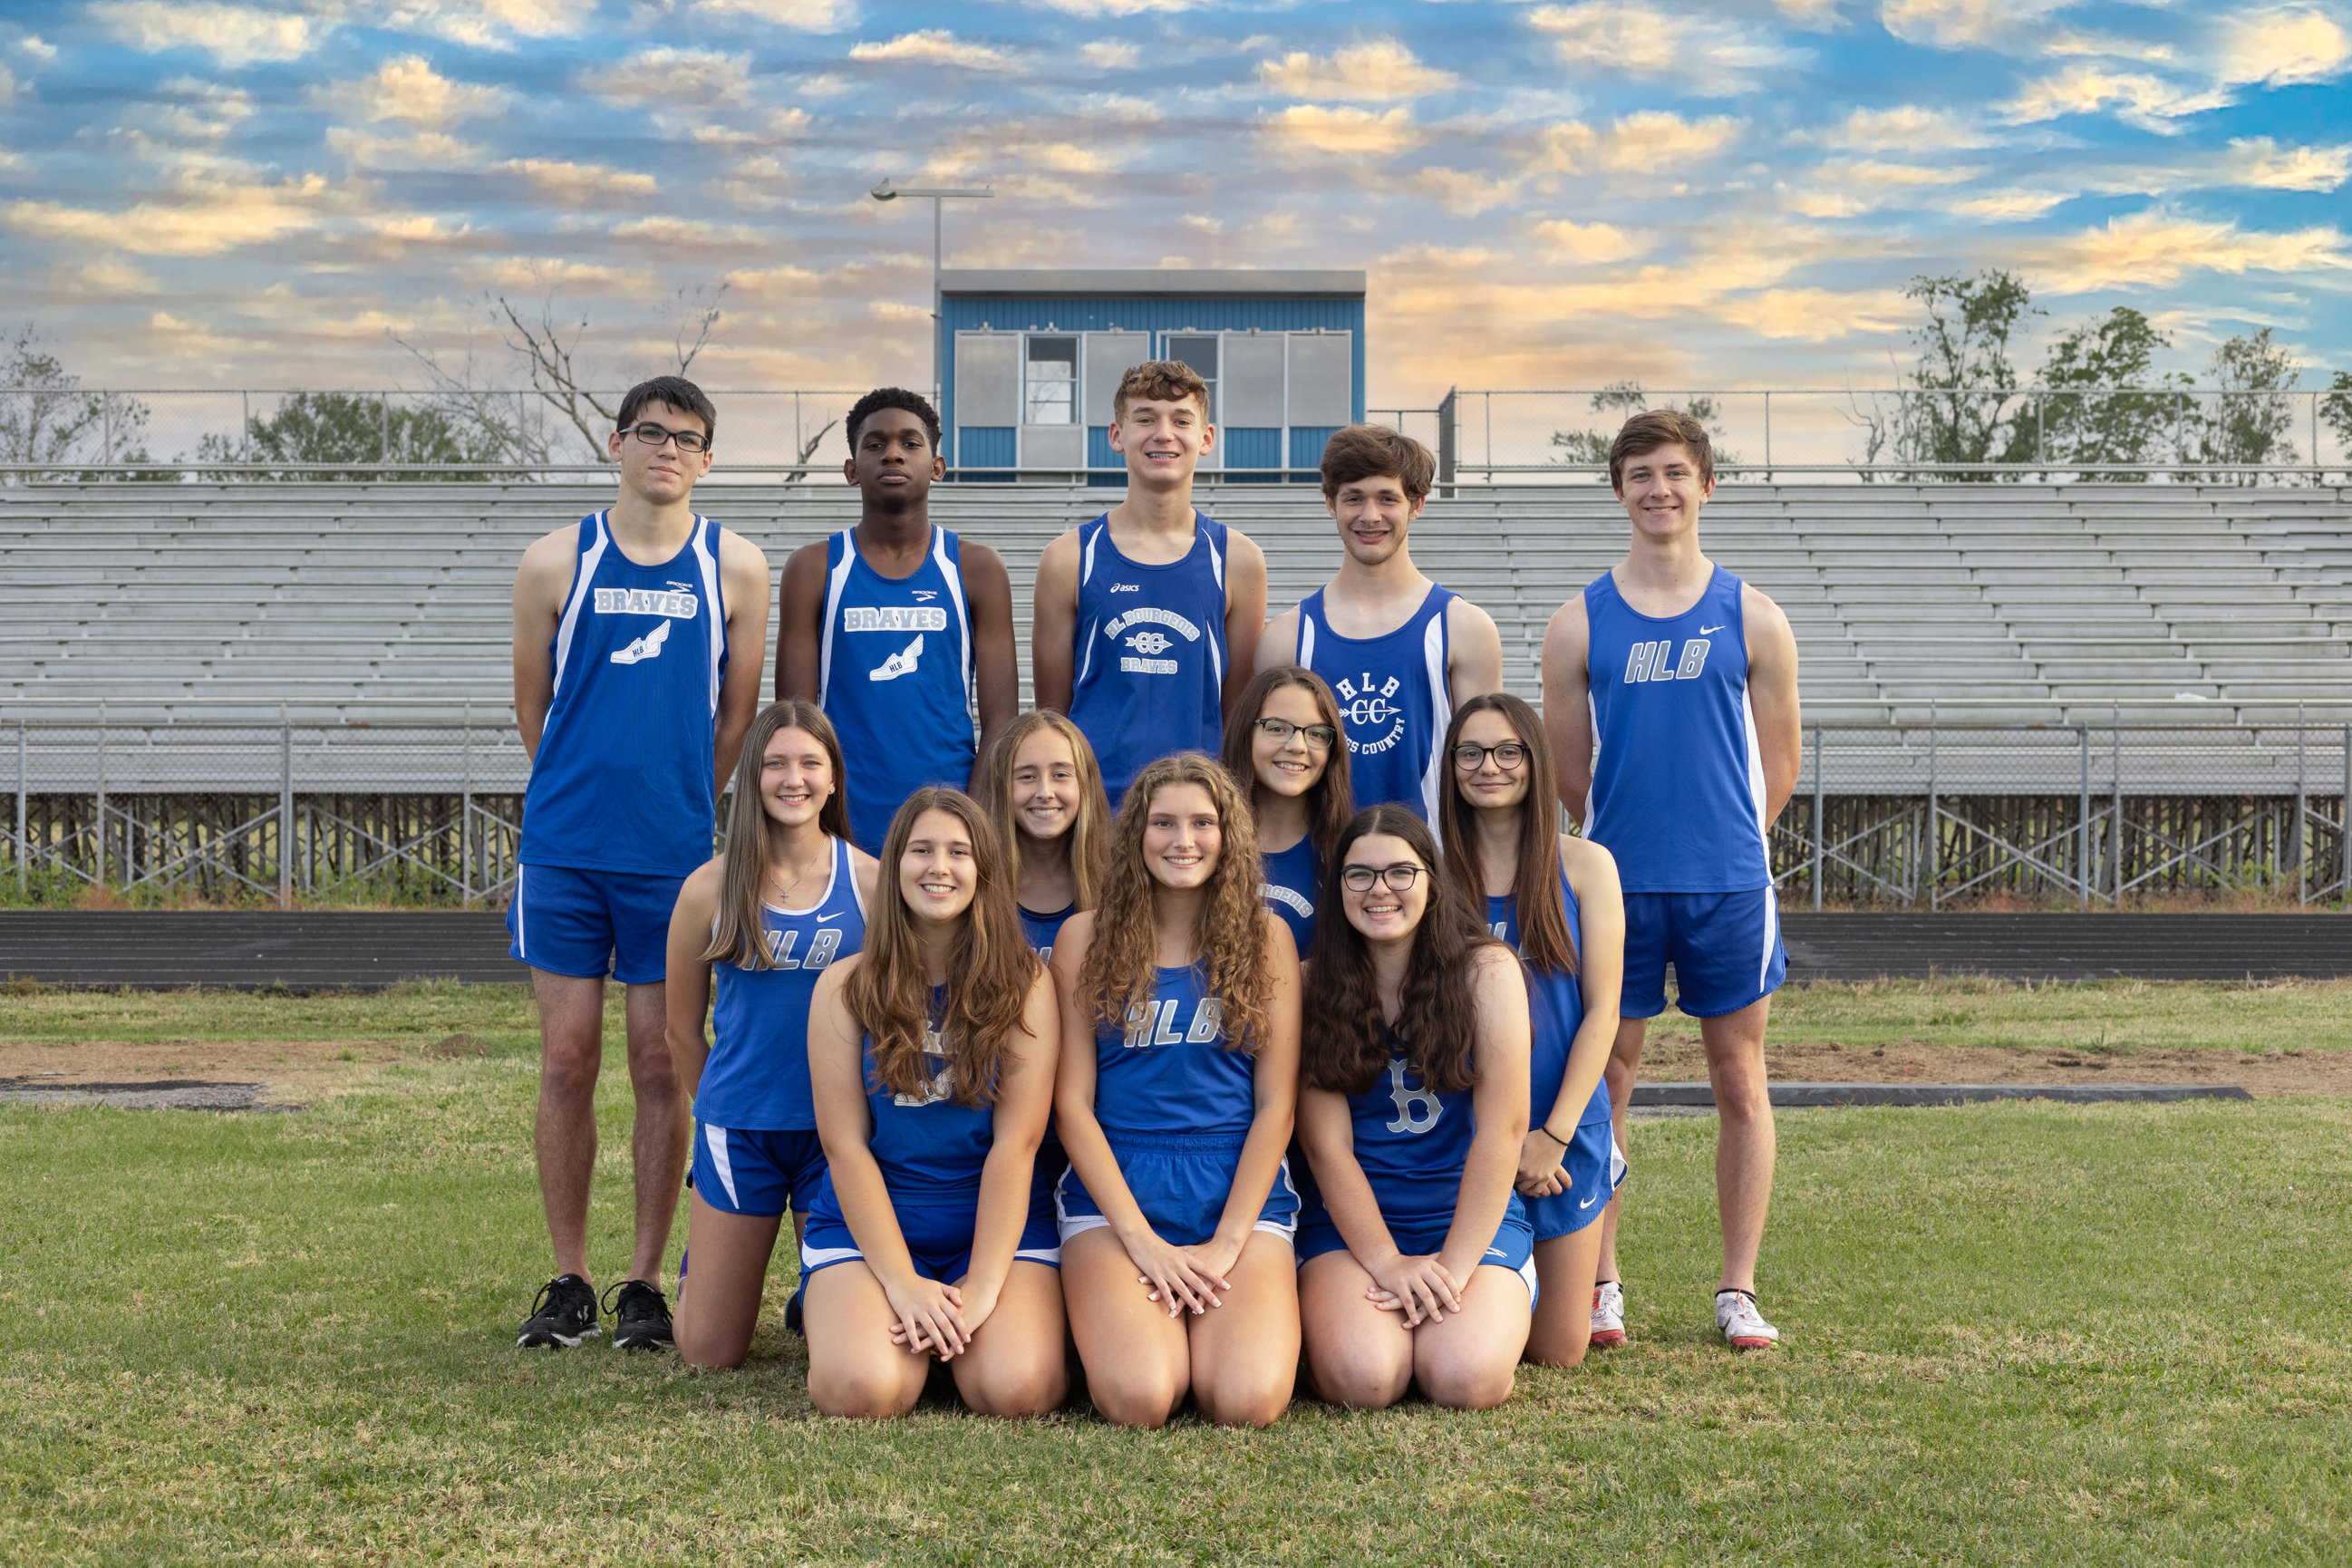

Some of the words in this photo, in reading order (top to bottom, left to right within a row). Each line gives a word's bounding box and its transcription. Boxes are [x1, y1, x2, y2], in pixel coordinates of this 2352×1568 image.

[595, 588, 698, 619] BRAVES
[845, 606, 947, 632] BRAVES
[1104, 617, 1127, 640] HL
[1121, 607, 1201, 642] BOURGEOIS
[632, 645, 644, 657] HLB
[1120, 657, 1178, 674] BRAVES
[1624, 639, 1711, 683] HLB
[889, 661, 903, 673] HLB
[1361, 717, 1405, 755] COUNTRY
[1124, 997, 1223, 1048] HLB
